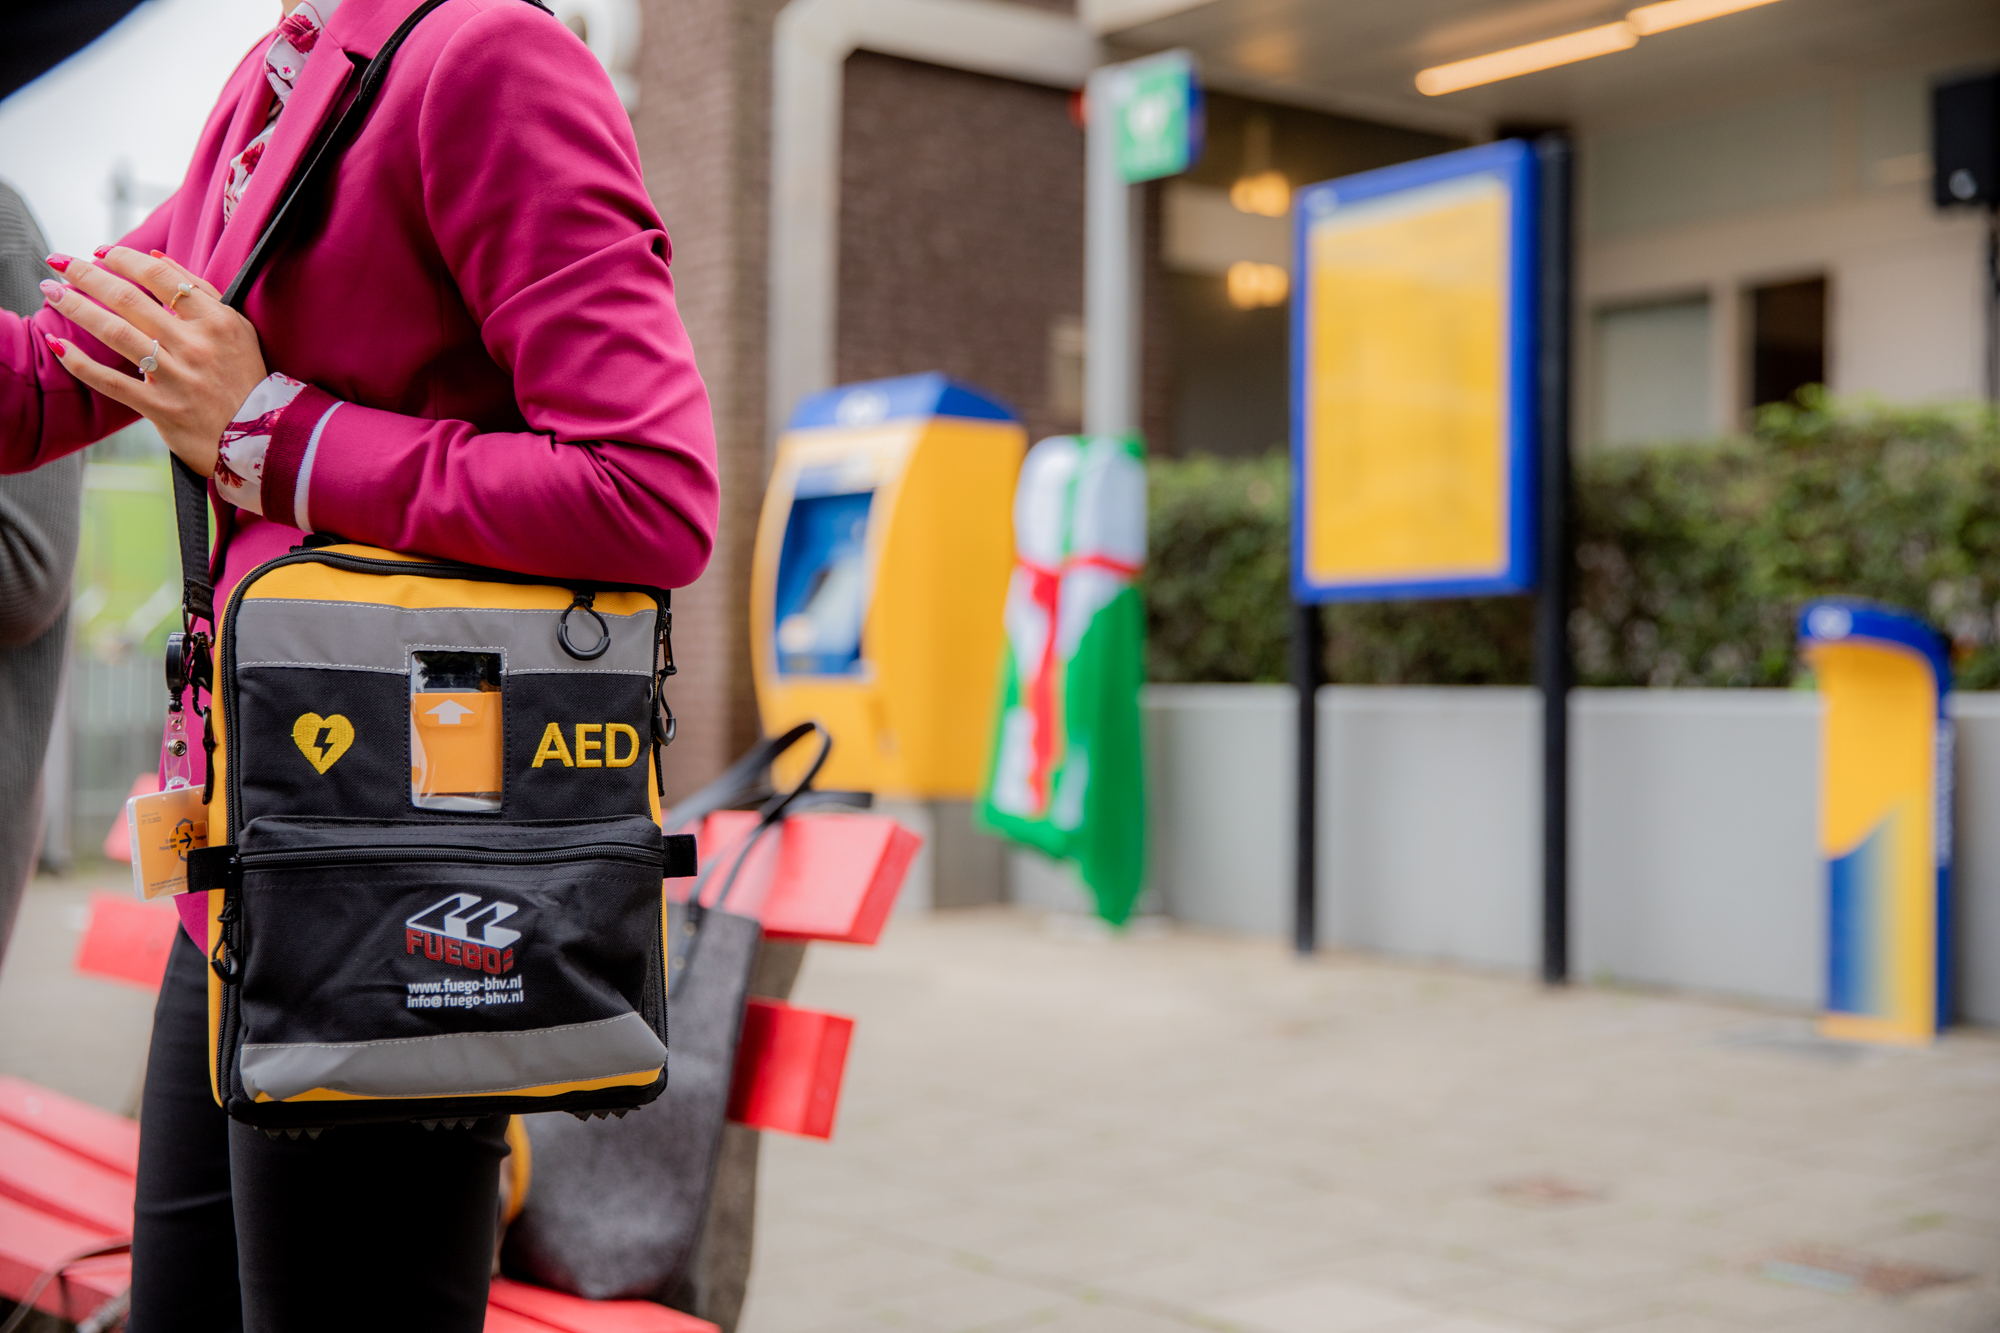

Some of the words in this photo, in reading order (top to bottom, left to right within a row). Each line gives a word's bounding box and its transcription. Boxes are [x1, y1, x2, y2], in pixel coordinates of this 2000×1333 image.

[531, 722, 640, 768] AED
[406, 928, 501, 975] FUEGO
[406, 990, 524, 1009] info@fuego-bhv.nl
[407, 974, 522, 995] www.fuego-bhv.nl
